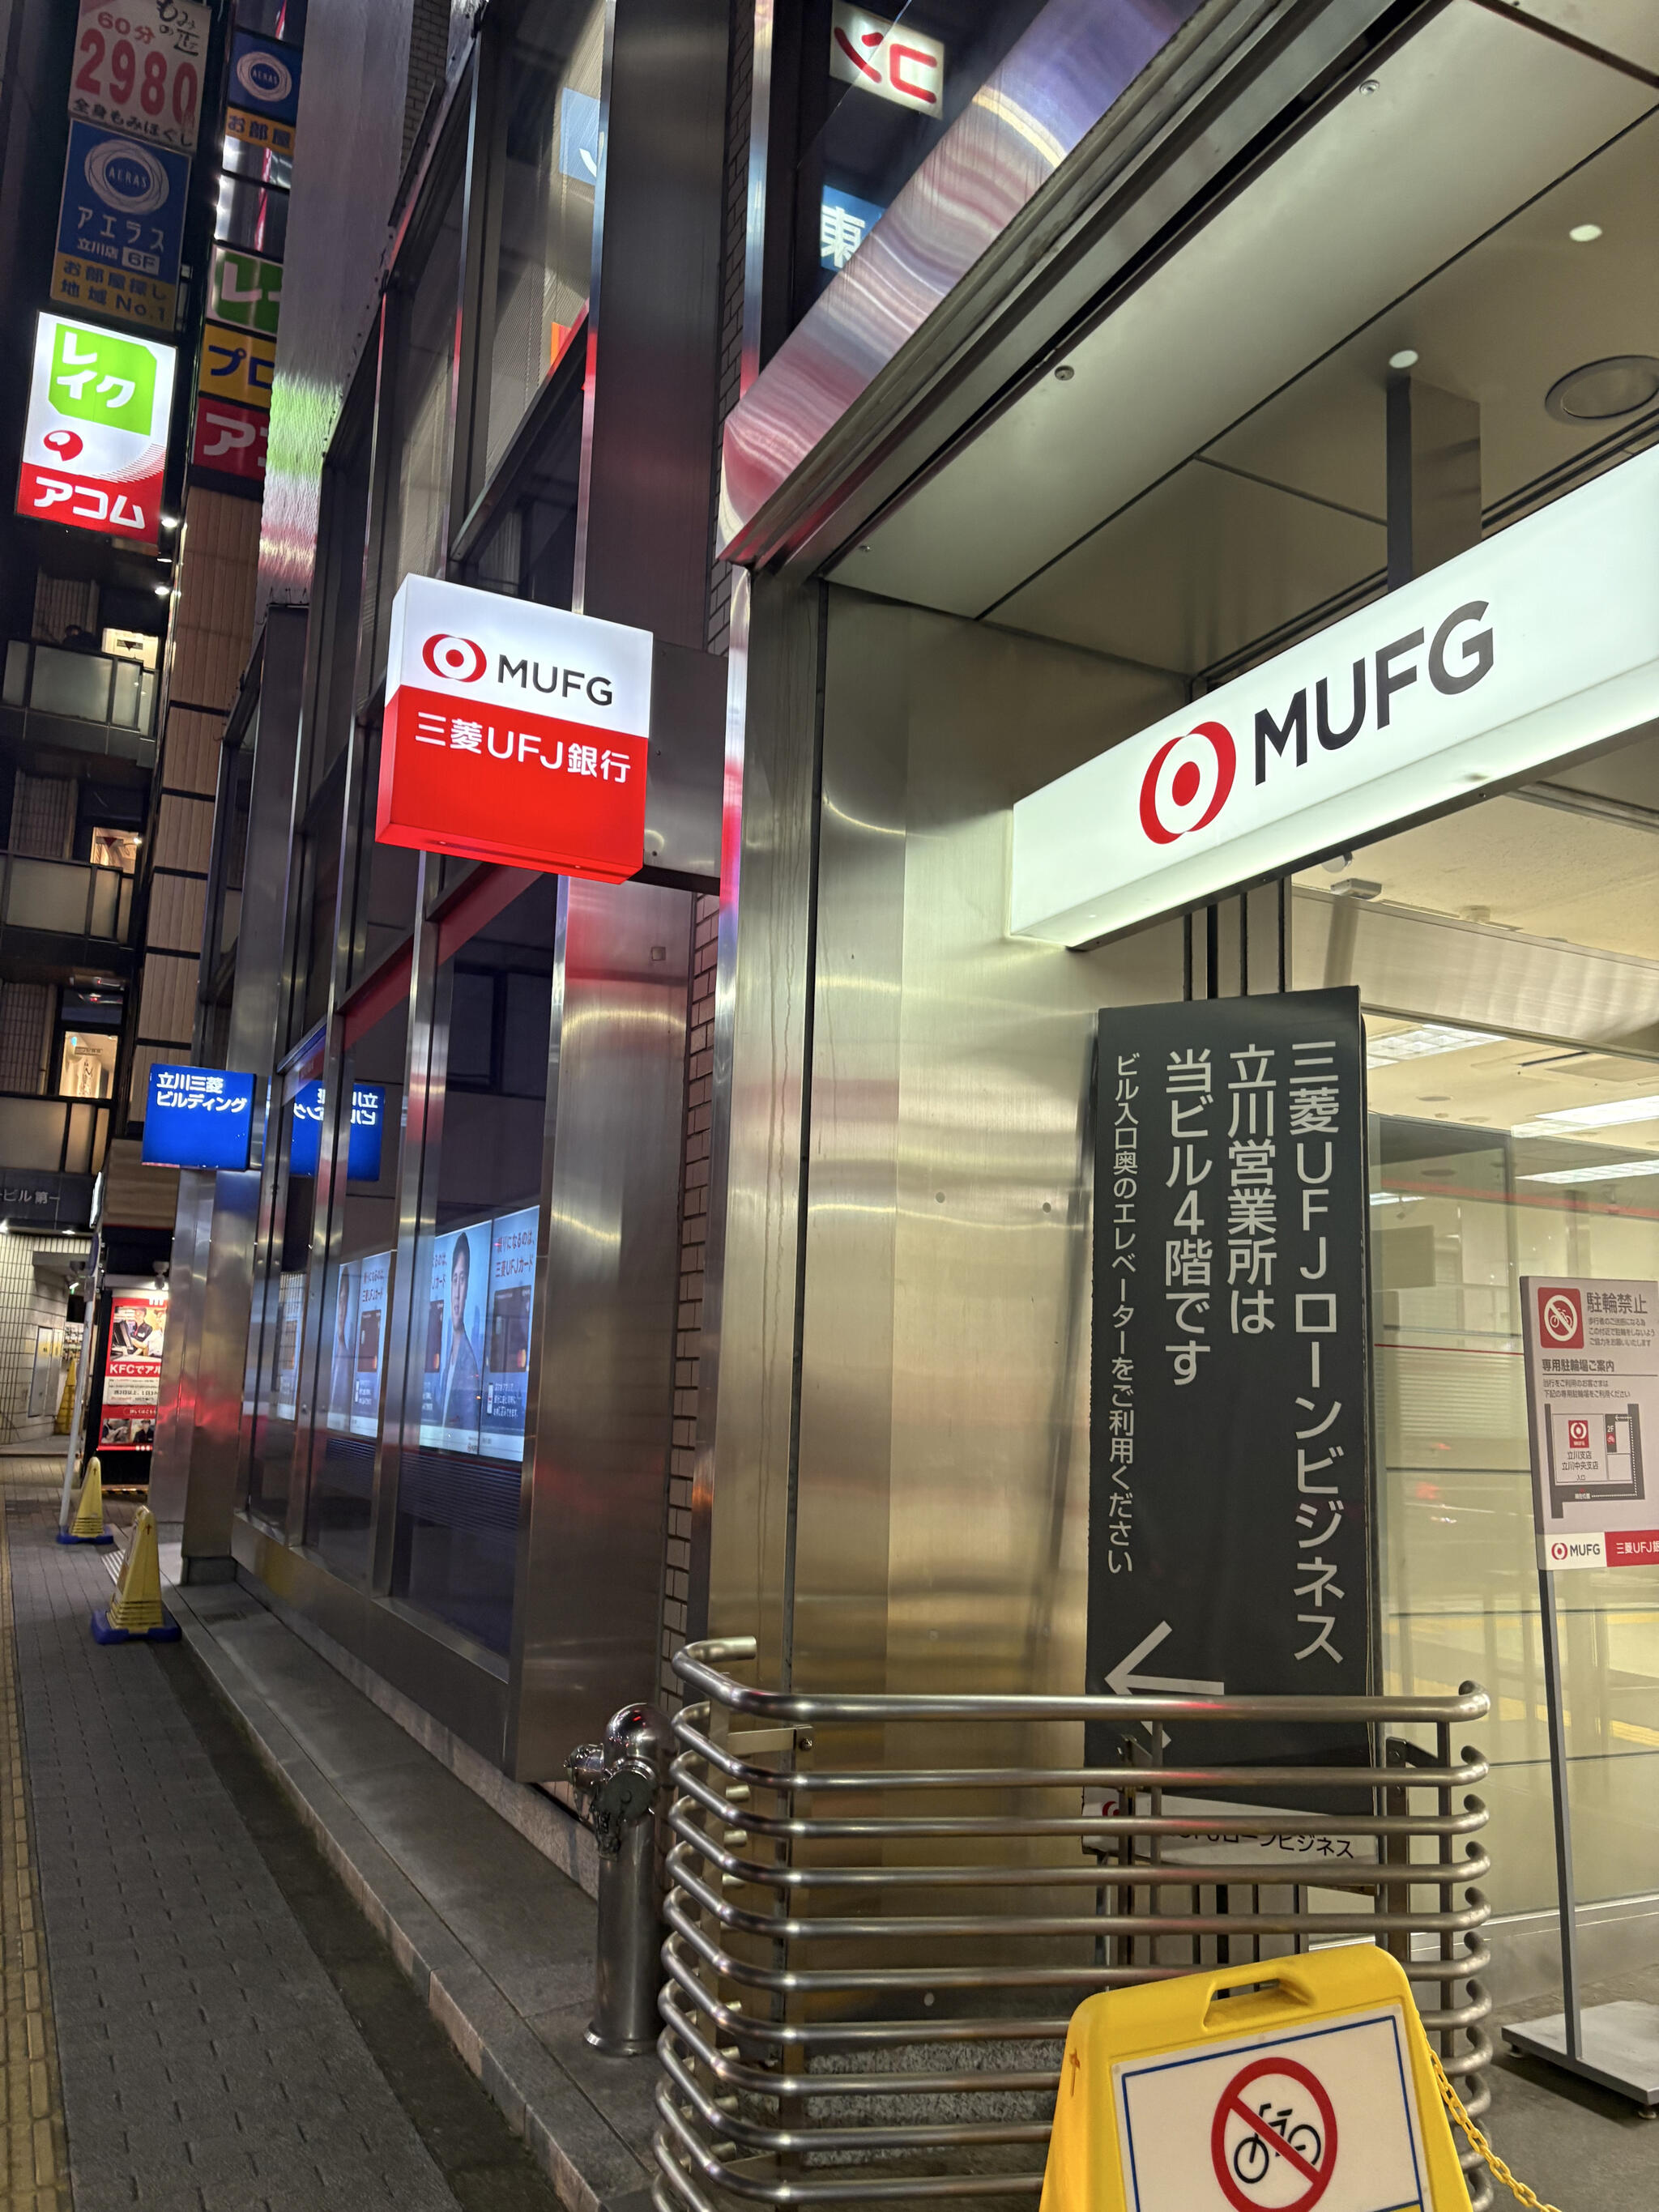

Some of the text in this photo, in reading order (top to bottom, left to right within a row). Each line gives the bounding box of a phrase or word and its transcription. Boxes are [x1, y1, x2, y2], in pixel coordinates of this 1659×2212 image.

[97, 11, 156, 45] 60分
[75, 28, 199, 126] 2980
[72, 98, 194, 147] 全身もみほぐし
[77, 207, 164, 253] アエラス
[77, 237, 118, 260] 立川店
[63, 259, 167, 301] お部屋探し
[127, 252, 156, 269] 6F
[203, 412, 268, 467] ア
[33, 476, 146, 530] アコム
[497, 654, 612, 706] MUFG
[1254, 599, 1495, 786] MUFG
[415, 711, 631, 783] 三菱UFJ銀行
[156, 1072, 224, 1094] 立川三菱
[156, 1091, 247, 1113] ビルディング
[1226, 1043, 1277, 1334] 立川営業所は
[1165, 1048, 1214, 1386] 当ビル4階です
[1107, 1052, 1140, 1575] ビル入口奥のエレベーターをご利用ください
[1586, 1292, 1648, 1315] 駐輪禁止
[1289, 1041, 1345, 1664] 三菱UFJローンビジネス
[1542, 1358, 1614, 1373] 専用駐輪場ご案内
[1562, 1461, 1599, 1471] 立川中央支店
[1567, 1451, 1593, 1460] 立川支店
[1570, 1544, 1601, 1557] MUFG
